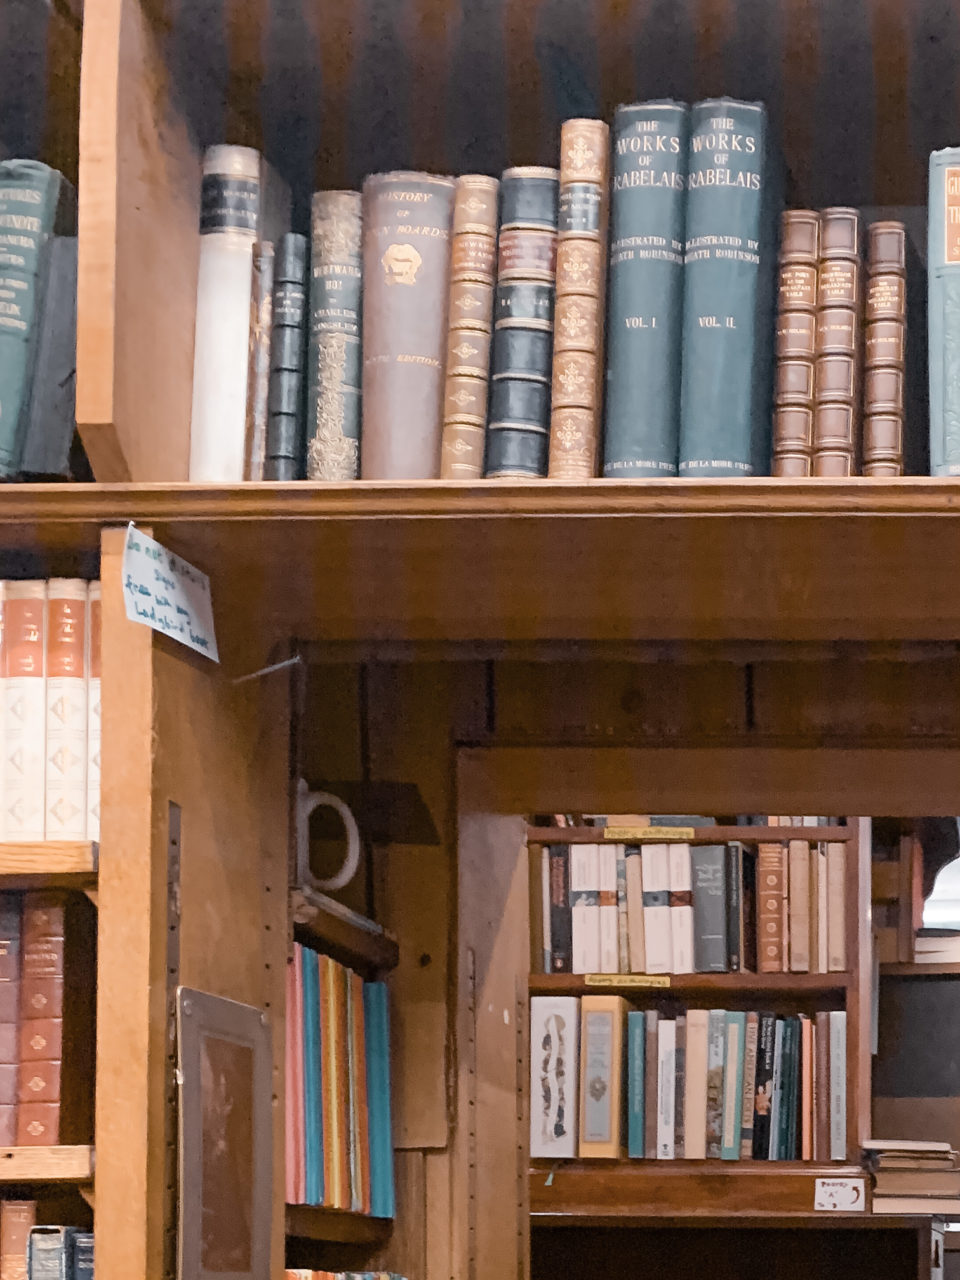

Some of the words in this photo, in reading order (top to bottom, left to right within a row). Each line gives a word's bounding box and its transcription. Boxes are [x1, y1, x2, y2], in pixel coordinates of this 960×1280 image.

[636, 120, 659, 132] THE
[710, 118, 735, 130] THE
[617, 135, 680, 155] WORKS
[692, 134, 756, 153] WORKS
[638, 155, 653, 167] OF
[714, 154, 729, 165] OF
[613, 170, 684, 192] RABELAIS
[688, 168, 760, 190] RABELAIS
[671, 240, 682, 251] BY
[747, 239, 759, 250] BY
